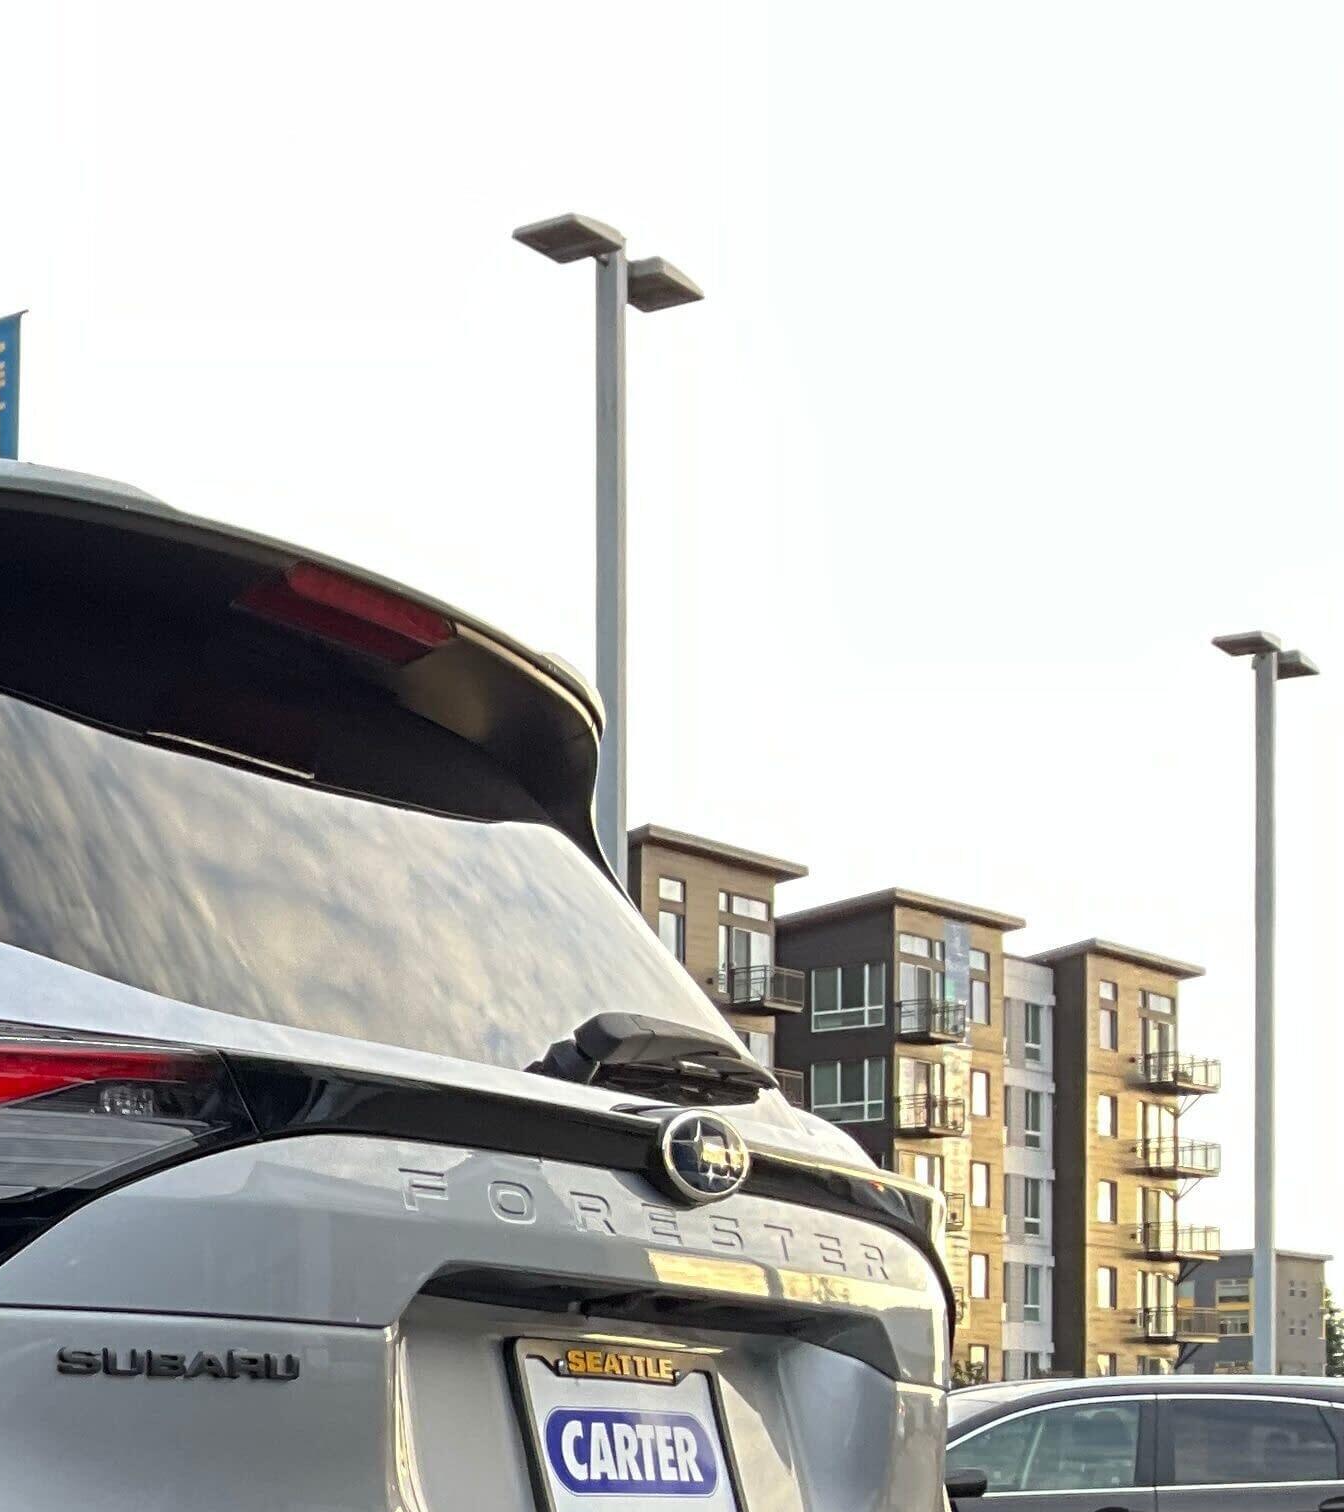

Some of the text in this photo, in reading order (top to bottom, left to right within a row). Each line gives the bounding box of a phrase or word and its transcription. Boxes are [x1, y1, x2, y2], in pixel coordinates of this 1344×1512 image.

[397, 1166, 890, 1281] FORESTER
[56, 1347, 300, 1381] SUBARU
[566, 1349, 675, 1381] SEATTLE
[561, 1419, 704, 1483] CARTER
